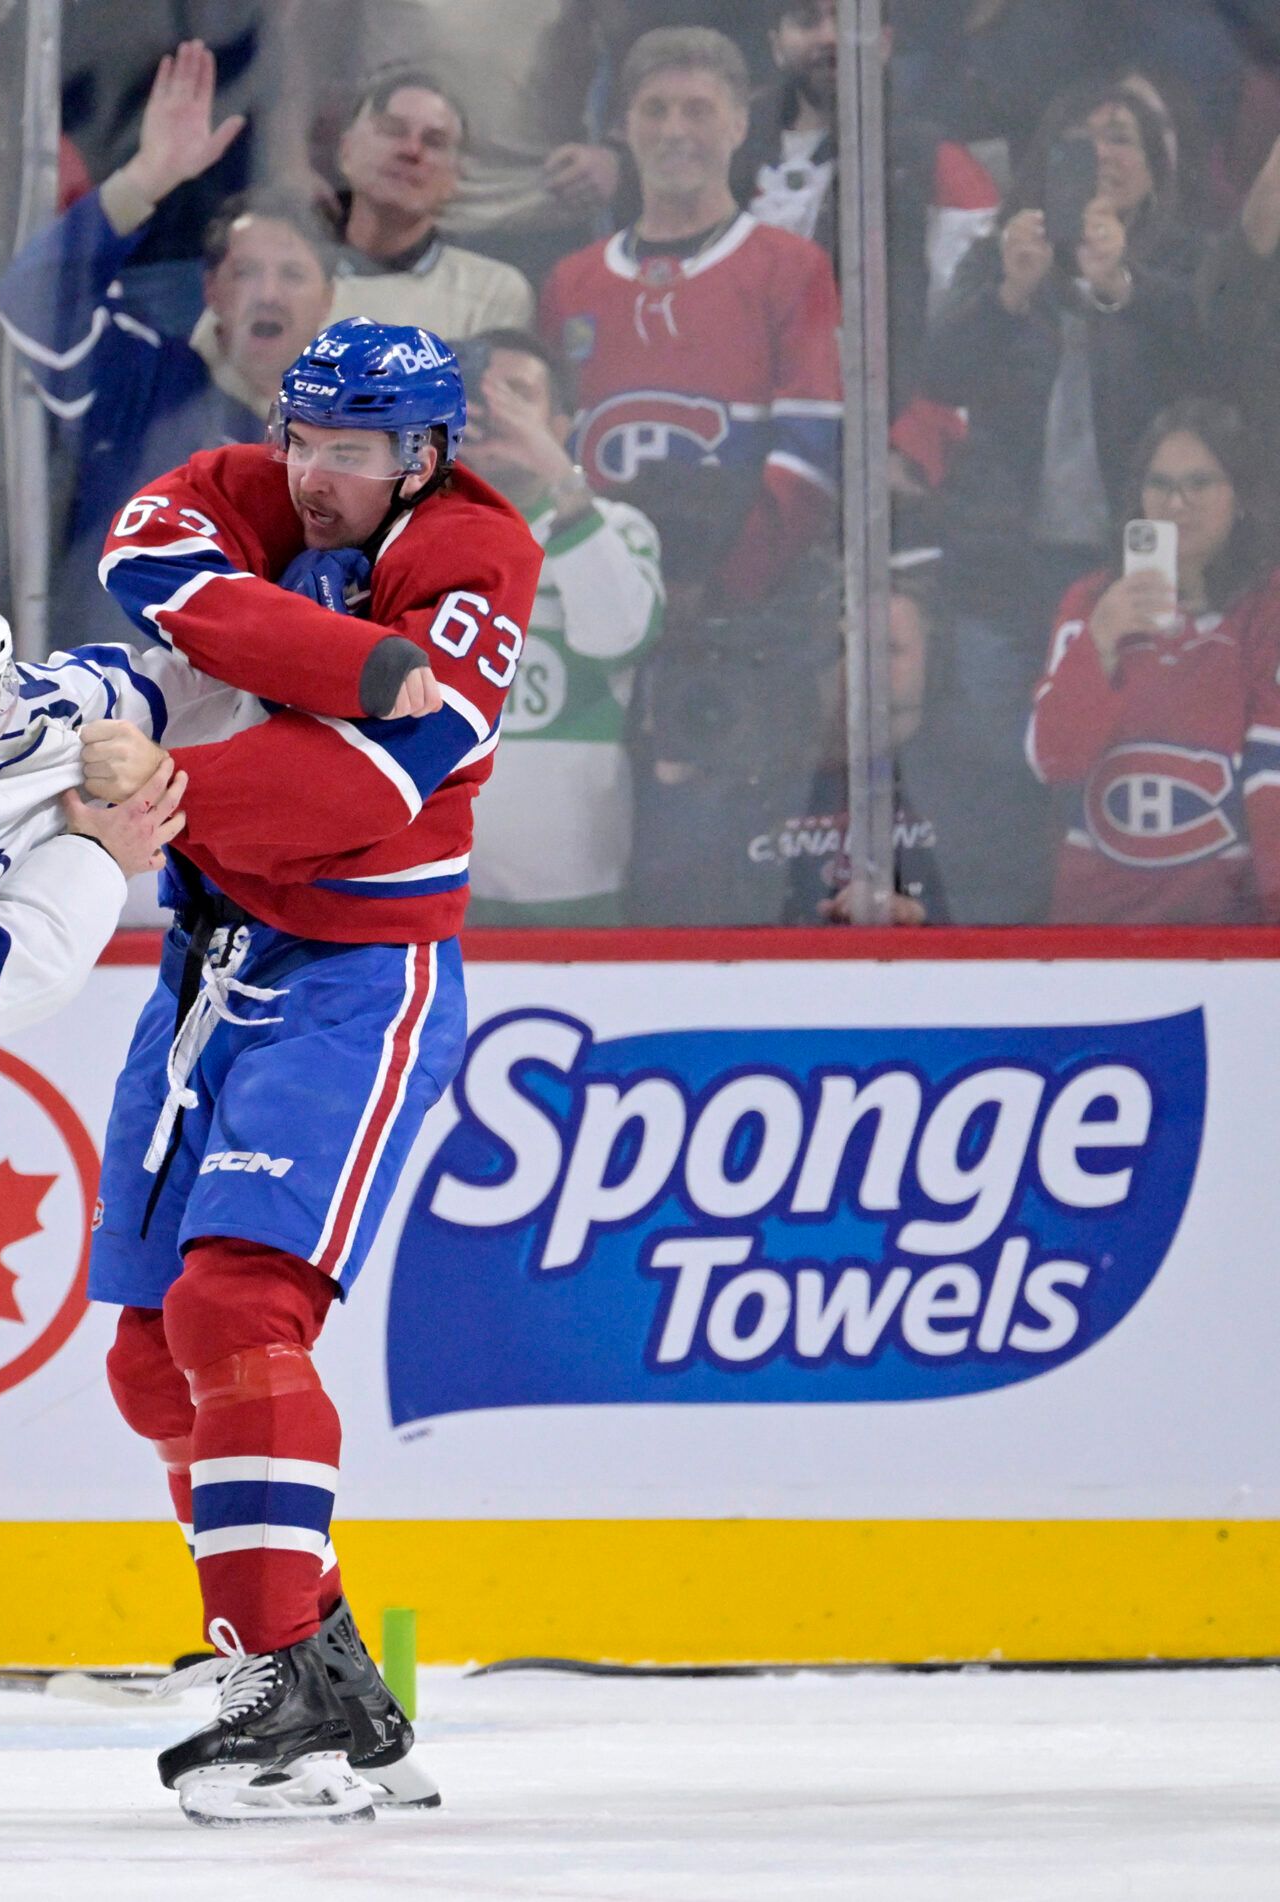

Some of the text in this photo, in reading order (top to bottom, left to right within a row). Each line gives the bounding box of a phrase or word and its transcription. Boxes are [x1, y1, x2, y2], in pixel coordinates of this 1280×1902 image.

[314, 340, 351, 359] 63
[392, 328, 446, 375] Bell
[293, 378, 339, 397] CCM
[429, 589, 524, 689] 63
[199, 1151, 294, 1178] CCM
[429, 1019, 1152, 1270] Sponge
[652, 1238, 1088, 1362] Towels
